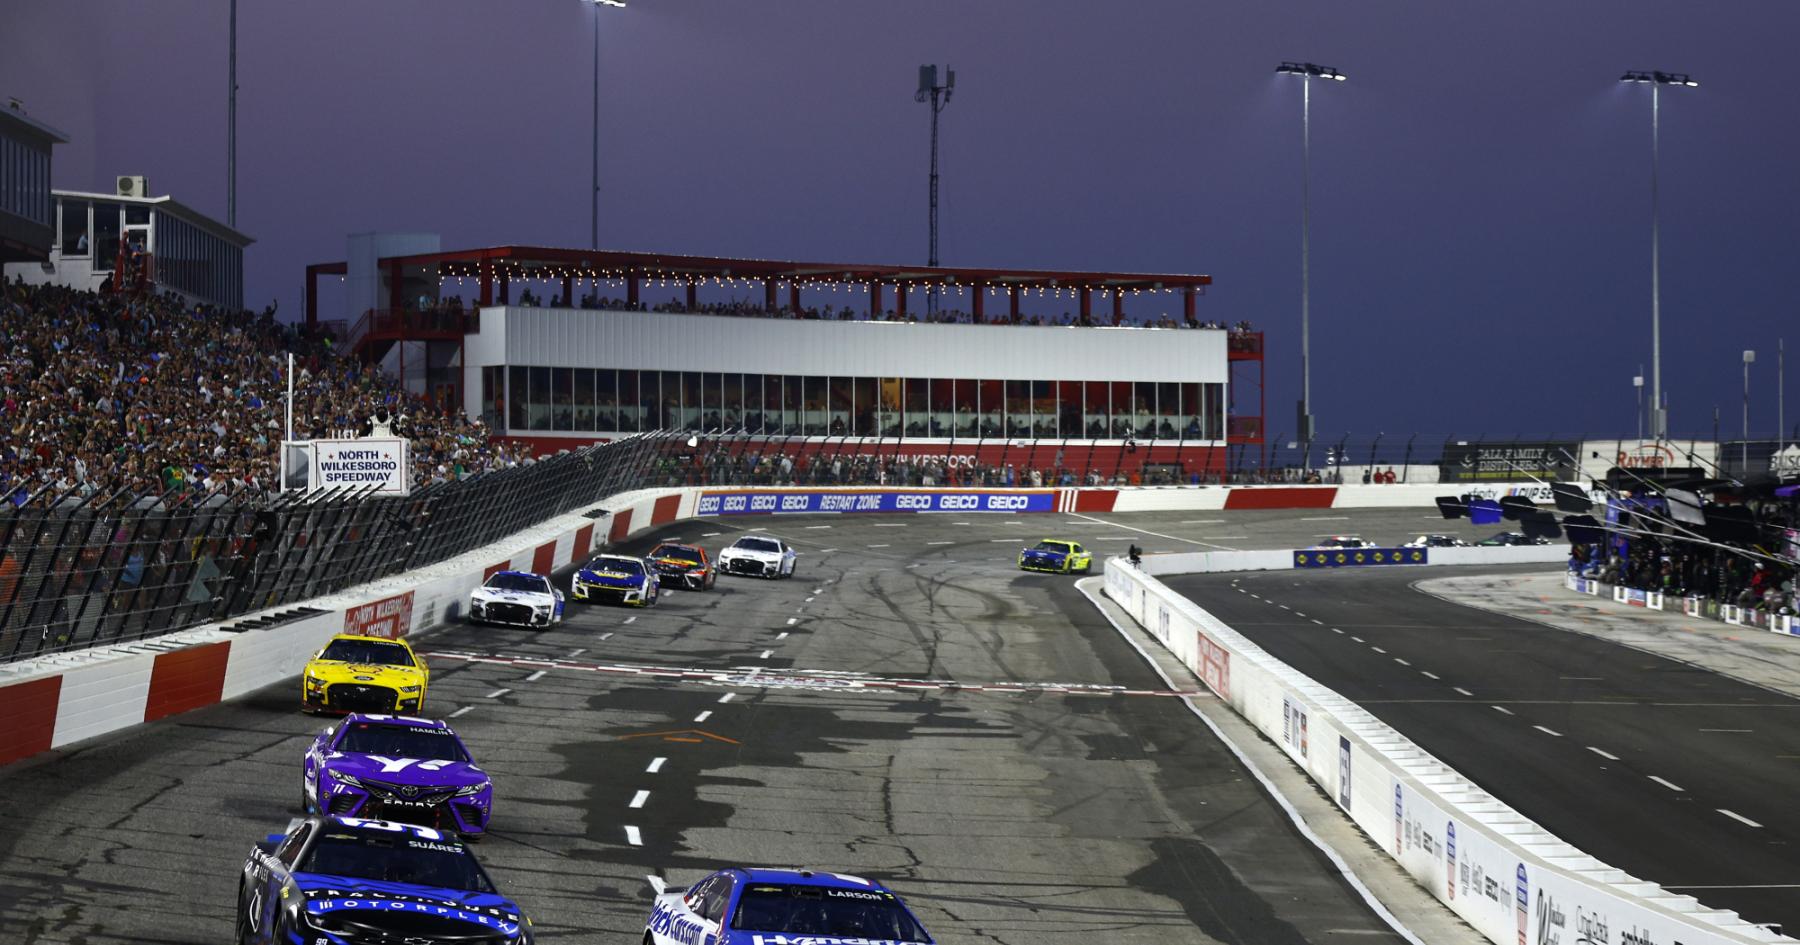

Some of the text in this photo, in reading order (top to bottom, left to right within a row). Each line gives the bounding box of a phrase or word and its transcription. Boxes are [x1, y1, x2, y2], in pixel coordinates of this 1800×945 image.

[338, 450, 379, 460] NORTH
[1618, 451, 1665, 468] RAYMER
[320, 461, 397, 471] WILKESBORO
[1478, 460, 1539, 471] DISTILERS
[326, 472, 392, 482] SPEEDWAY
[1519, 487, 1539, 499] CUP
[700, 495, 1028, 511] GEICO GEICO GEICO GEICO RESTART ZONE GEICO GEICO GEICO
[410, 727, 448, 736] HAMLIN
[333, 784, 346, 794] 11
[383, 799, 436, 809] CAMRY
[827, 889, 882, 901] LARSON
[304, 890, 519, 921] TRACOUSE
